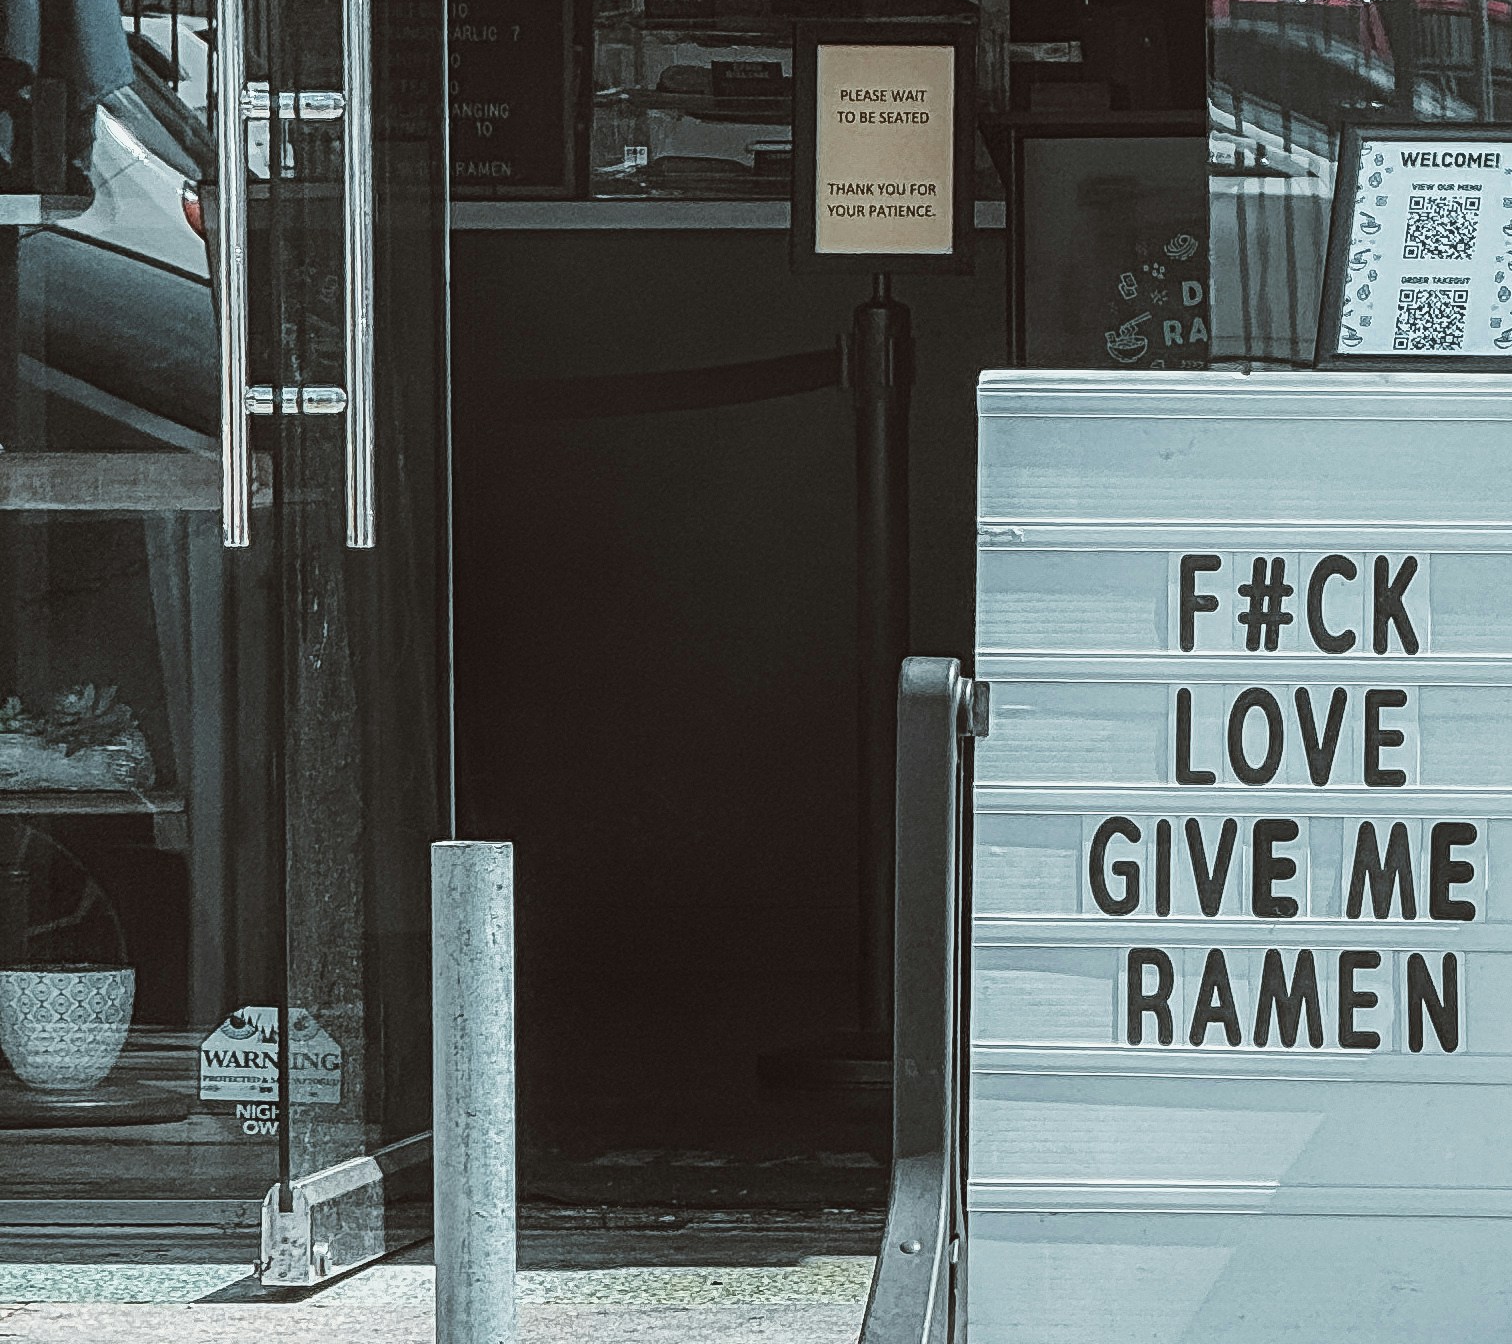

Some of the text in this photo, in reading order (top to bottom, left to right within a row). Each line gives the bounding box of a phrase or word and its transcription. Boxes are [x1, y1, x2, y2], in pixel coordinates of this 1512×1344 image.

[840, 89, 927, 102] PLEASE WAIT
[837, 111, 930, 124] TO BE SEATED
[1400, 152, 1501, 168] WELCOME!
[827, 183, 937, 196] THANK YOU FOR
[827, 205, 936, 217] YOUR PATIENCE.
[1179, 554, 1420, 655] F#CK
[1175, 687, 1408, 787] LOVE
[1088, 816, 1478, 922] GIVE ME
[1126, 947, 1460, 1054] RAMEN
[202, 1049, 340, 1072] WARNING
